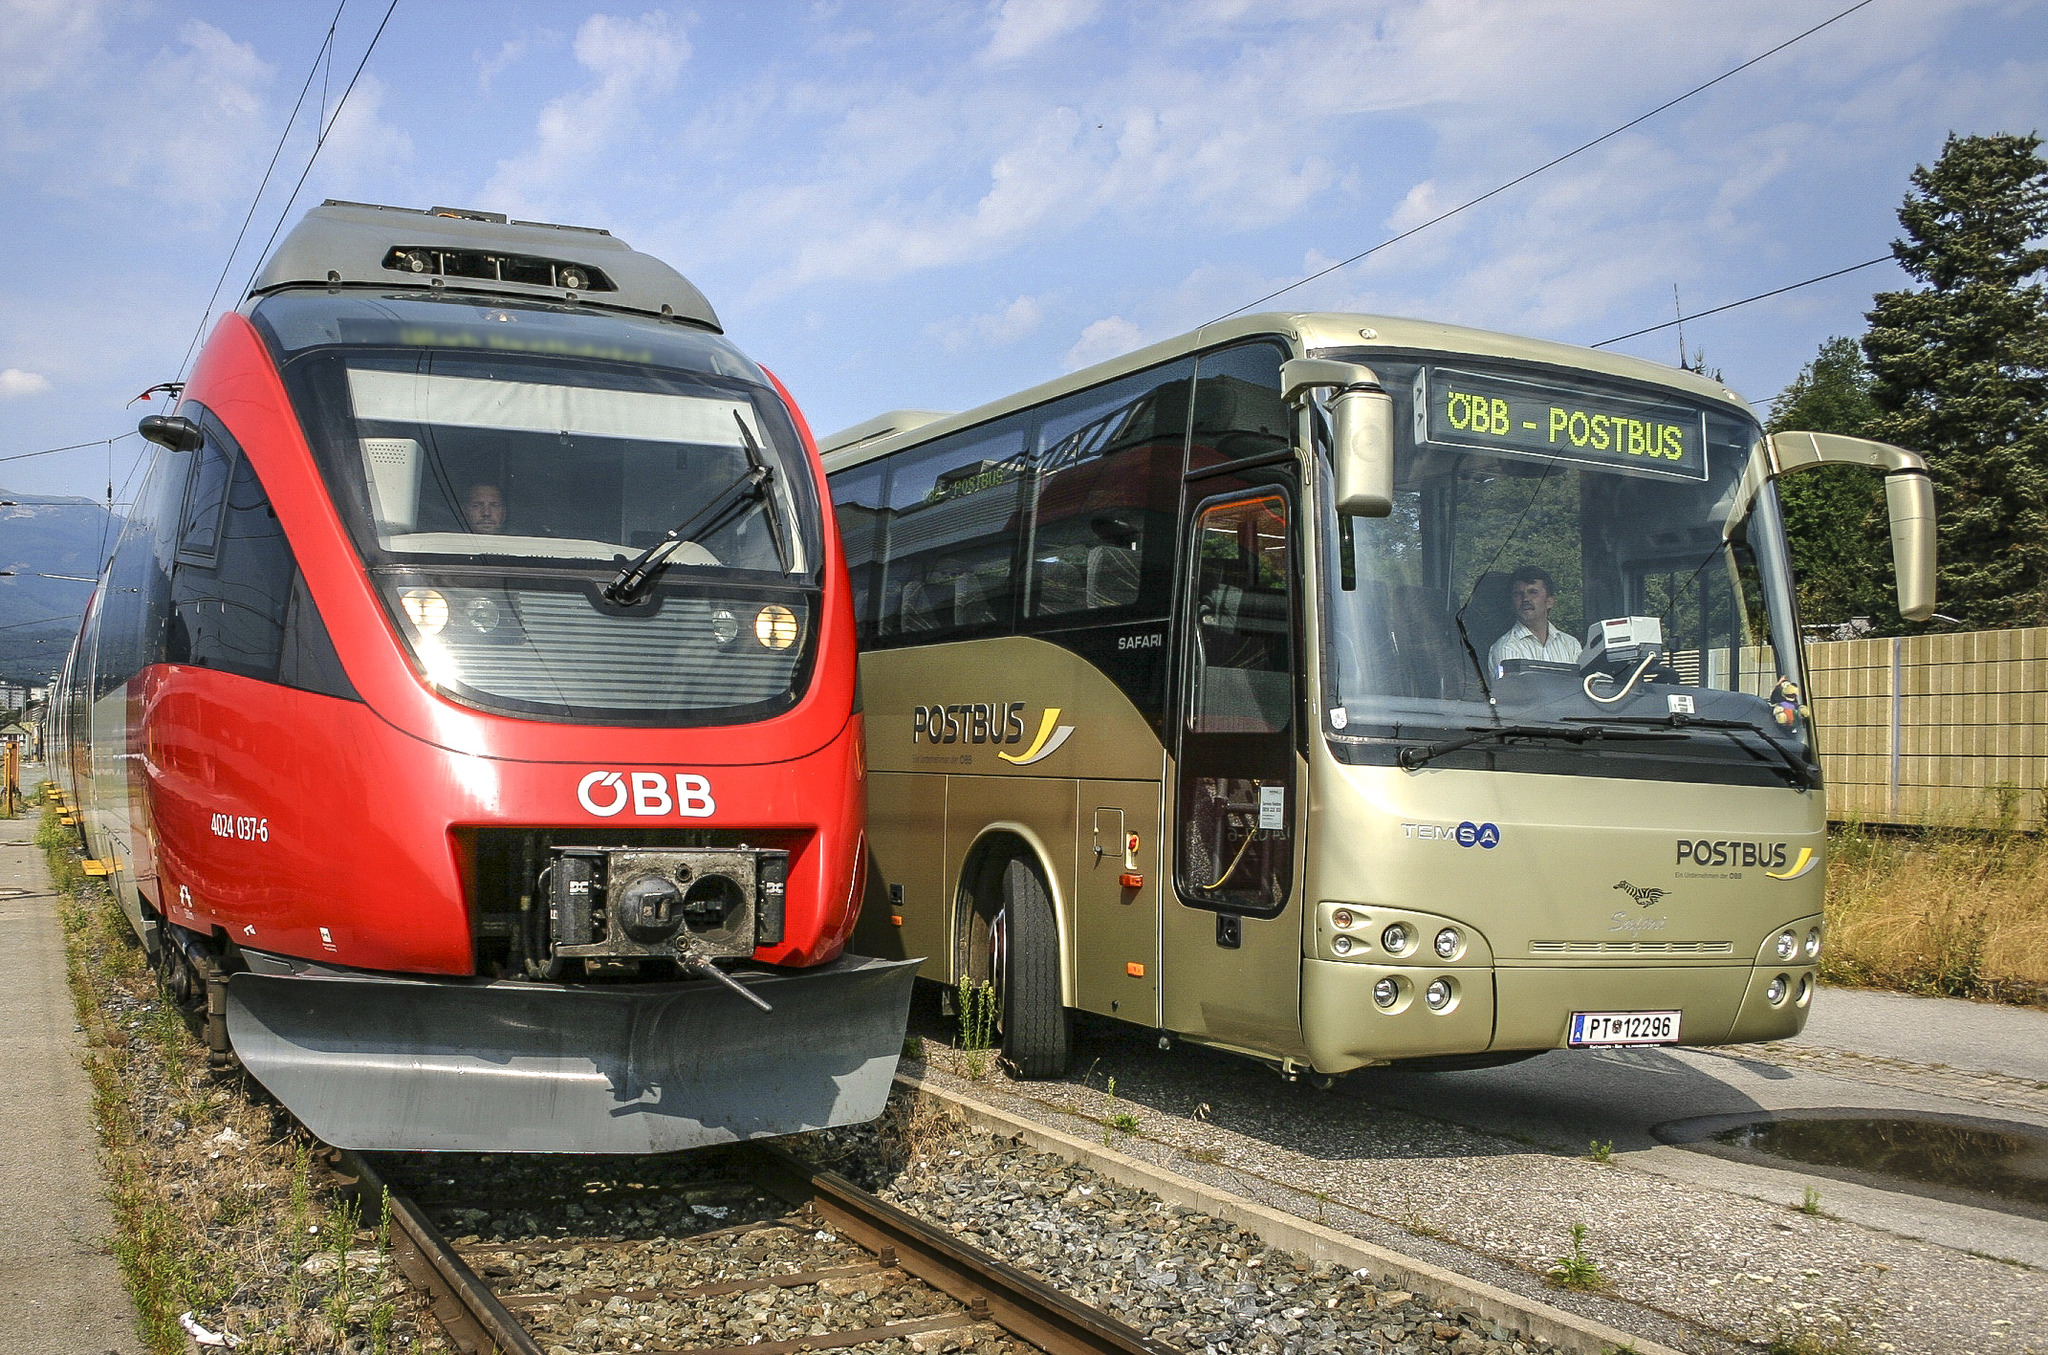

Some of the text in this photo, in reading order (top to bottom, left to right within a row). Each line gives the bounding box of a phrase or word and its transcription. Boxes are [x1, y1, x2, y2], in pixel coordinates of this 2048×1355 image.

[1447, 391, 1510, 436] ÖBB
[1549, 406, 1683, 461] POSTBUS
[1118, 633, 1162, 649] SAFARI
[913, 701, 1025, 744] POSTBUS
[578, 771, 716, 817] ÖBB
[211, 813, 269, 842] 4024 037-6
[1401, 822, 1498, 846] TEMSA
[1676, 840, 1787, 867] POSTBUS
[1608, 911, 1668, 938] Safari
[1589, 1018, 1612, 1039] PT
[1623, 1017, 1671, 1038] 12296
